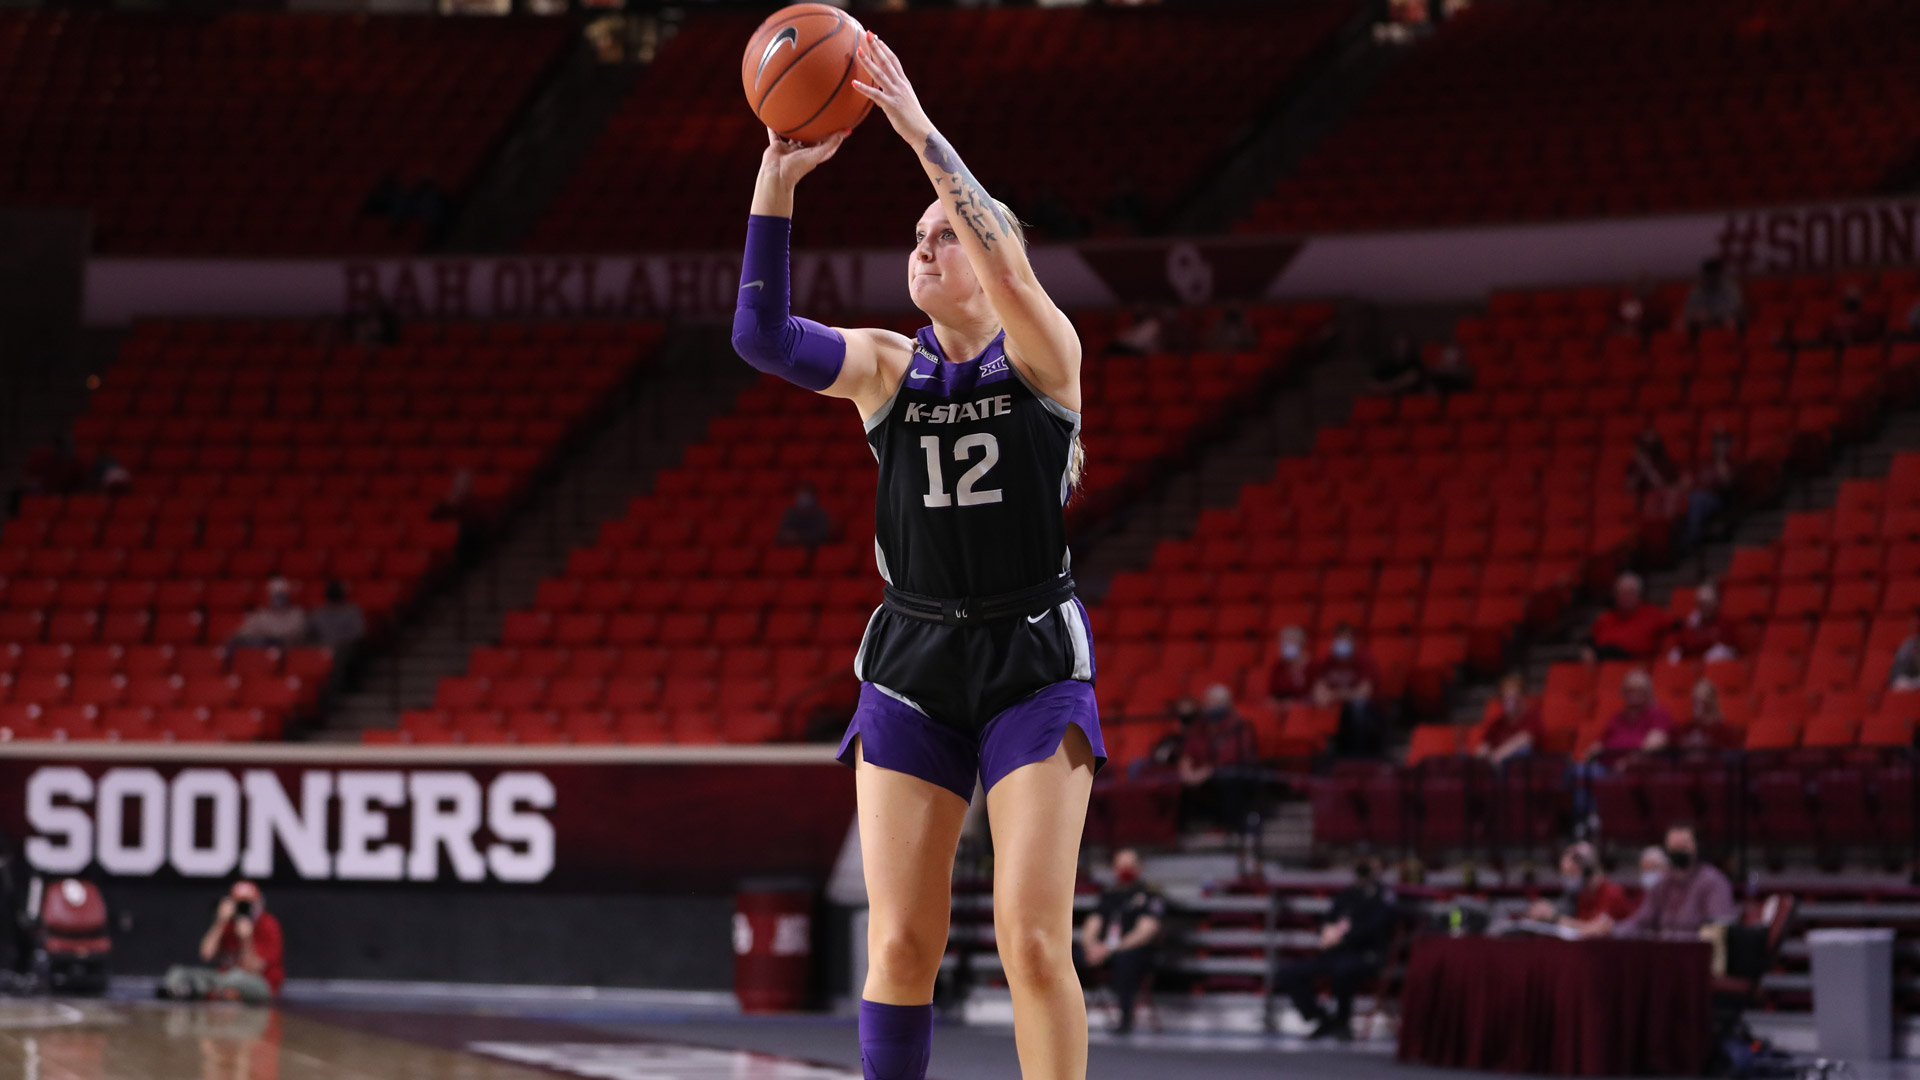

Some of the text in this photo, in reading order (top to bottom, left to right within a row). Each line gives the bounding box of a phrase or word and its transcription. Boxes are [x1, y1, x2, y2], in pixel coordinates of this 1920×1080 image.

[497, 256, 864, 316] OKLAHOA!
[904, 394, 1012, 424] K-STATE
[919, 432, 1003, 508] 12
[25, 766, 557, 883] SOONERS
